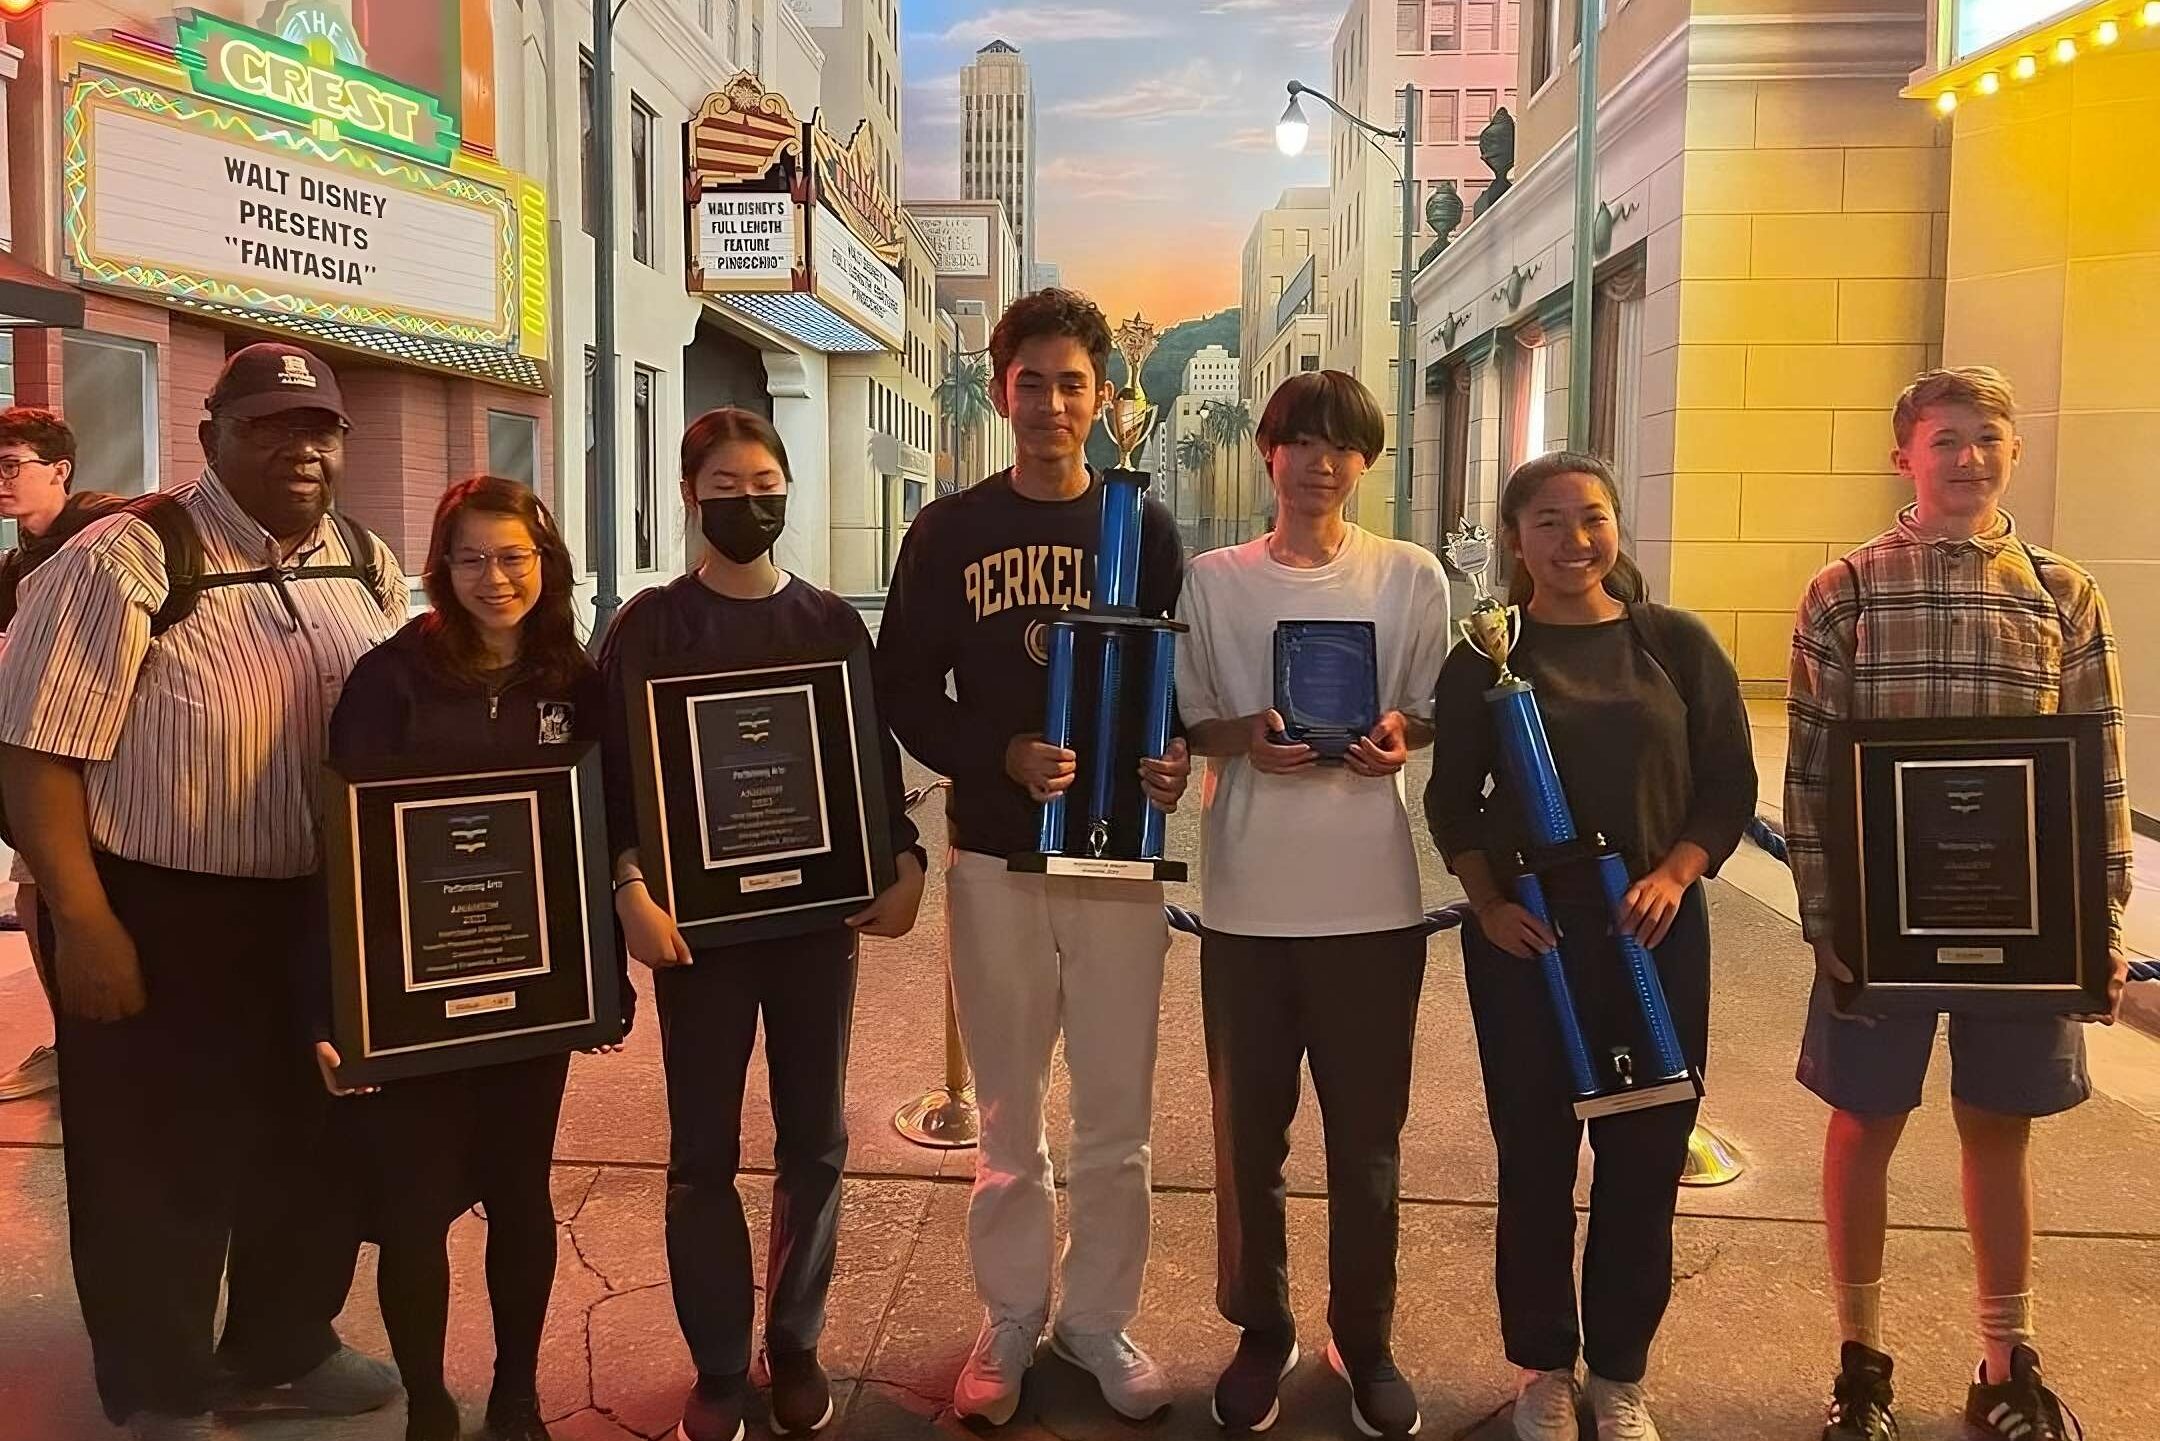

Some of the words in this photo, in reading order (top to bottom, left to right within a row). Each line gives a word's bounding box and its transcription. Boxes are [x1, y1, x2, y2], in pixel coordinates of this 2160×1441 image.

[296, 10, 343, 38] THE
[220, 39, 419, 143] CREST
[224, 156, 290, 195] WALT
[300, 176, 387, 219] DISNEY
[240, 200, 368, 250] PRESENTS
[707, 202, 735, 216] WALT
[711, 220, 737, 234] FULL
[740, 220, 782, 234] LENGTH
[224, 236, 377, 286] "FANTASIA"
[724, 238, 770, 252] FEATURE
